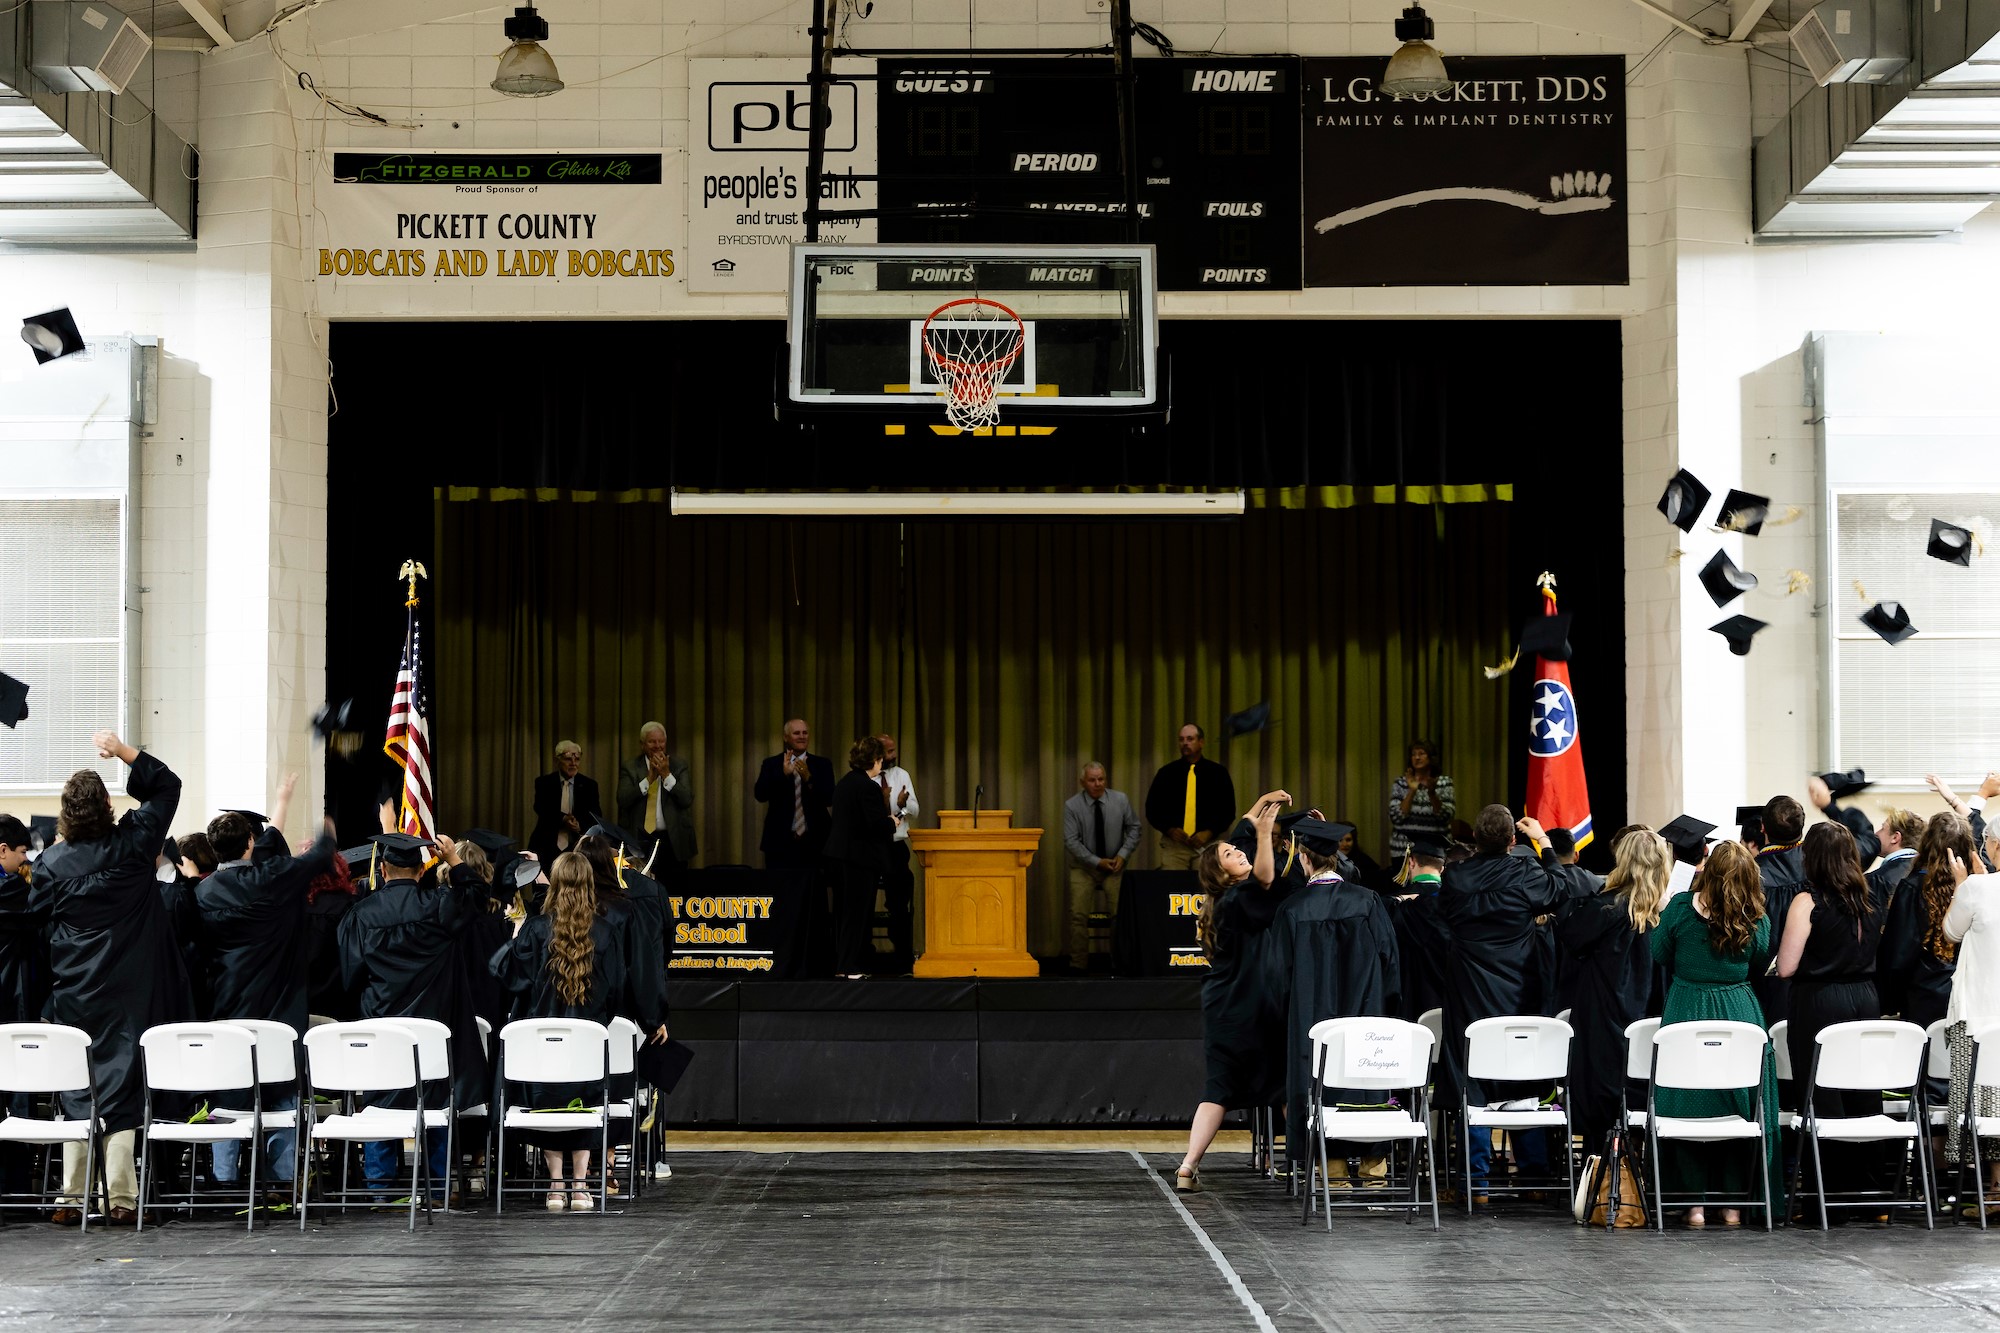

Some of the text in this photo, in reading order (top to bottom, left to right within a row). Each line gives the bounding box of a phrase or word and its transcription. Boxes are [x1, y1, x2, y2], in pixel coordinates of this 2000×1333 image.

[895, 70, 992, 93] GUEST
[1192, 70, 1275, 92] HOME
[1323, 77, 1380, 103] L.G.
[1536, 76, 1607, 103] DDS
[1316, 113, 1614, 126] FAMILY & IMPLANT DENTISTRY
[382, 160, 632, 181] FITZGERALD Glider Kits
[1013, 153, 1098, 172] PERIOD
[455, 185, 539, 195] Proud Sponsor of
[703, 166, 798, 209] people's
[736, 211, 760, 224] and
[765, 211, 799, 225] trust
[1206, 202, 1264, 218] FOULS
[397, 213, 597, 240] PICKETT COUNTY
[718, 234, 792, 245] BYRDSTOWN
[802, 234, 848, 244] ABANY
[318, 248, 675, 278] BOBCATS AND LADY BOBCATS
[830, 266, 854, 275] FDIC
[910, 267, 975, 283] POINTS
[1029, 267, 1095, 283] MATCH
[1202, 268, 1267, 283] POINTS
[686, 897, 773, 918] COUNTY
[676, 923, 747, 943] School
[715, 957, 725, 968] &
[726, 956, 774, 971] Integrity
[1365, 1032, 1394, 1041] Reserved
[1374, 1047, 1383, 1057] for
[1358, 1058, 1399, 1070] Photographer
